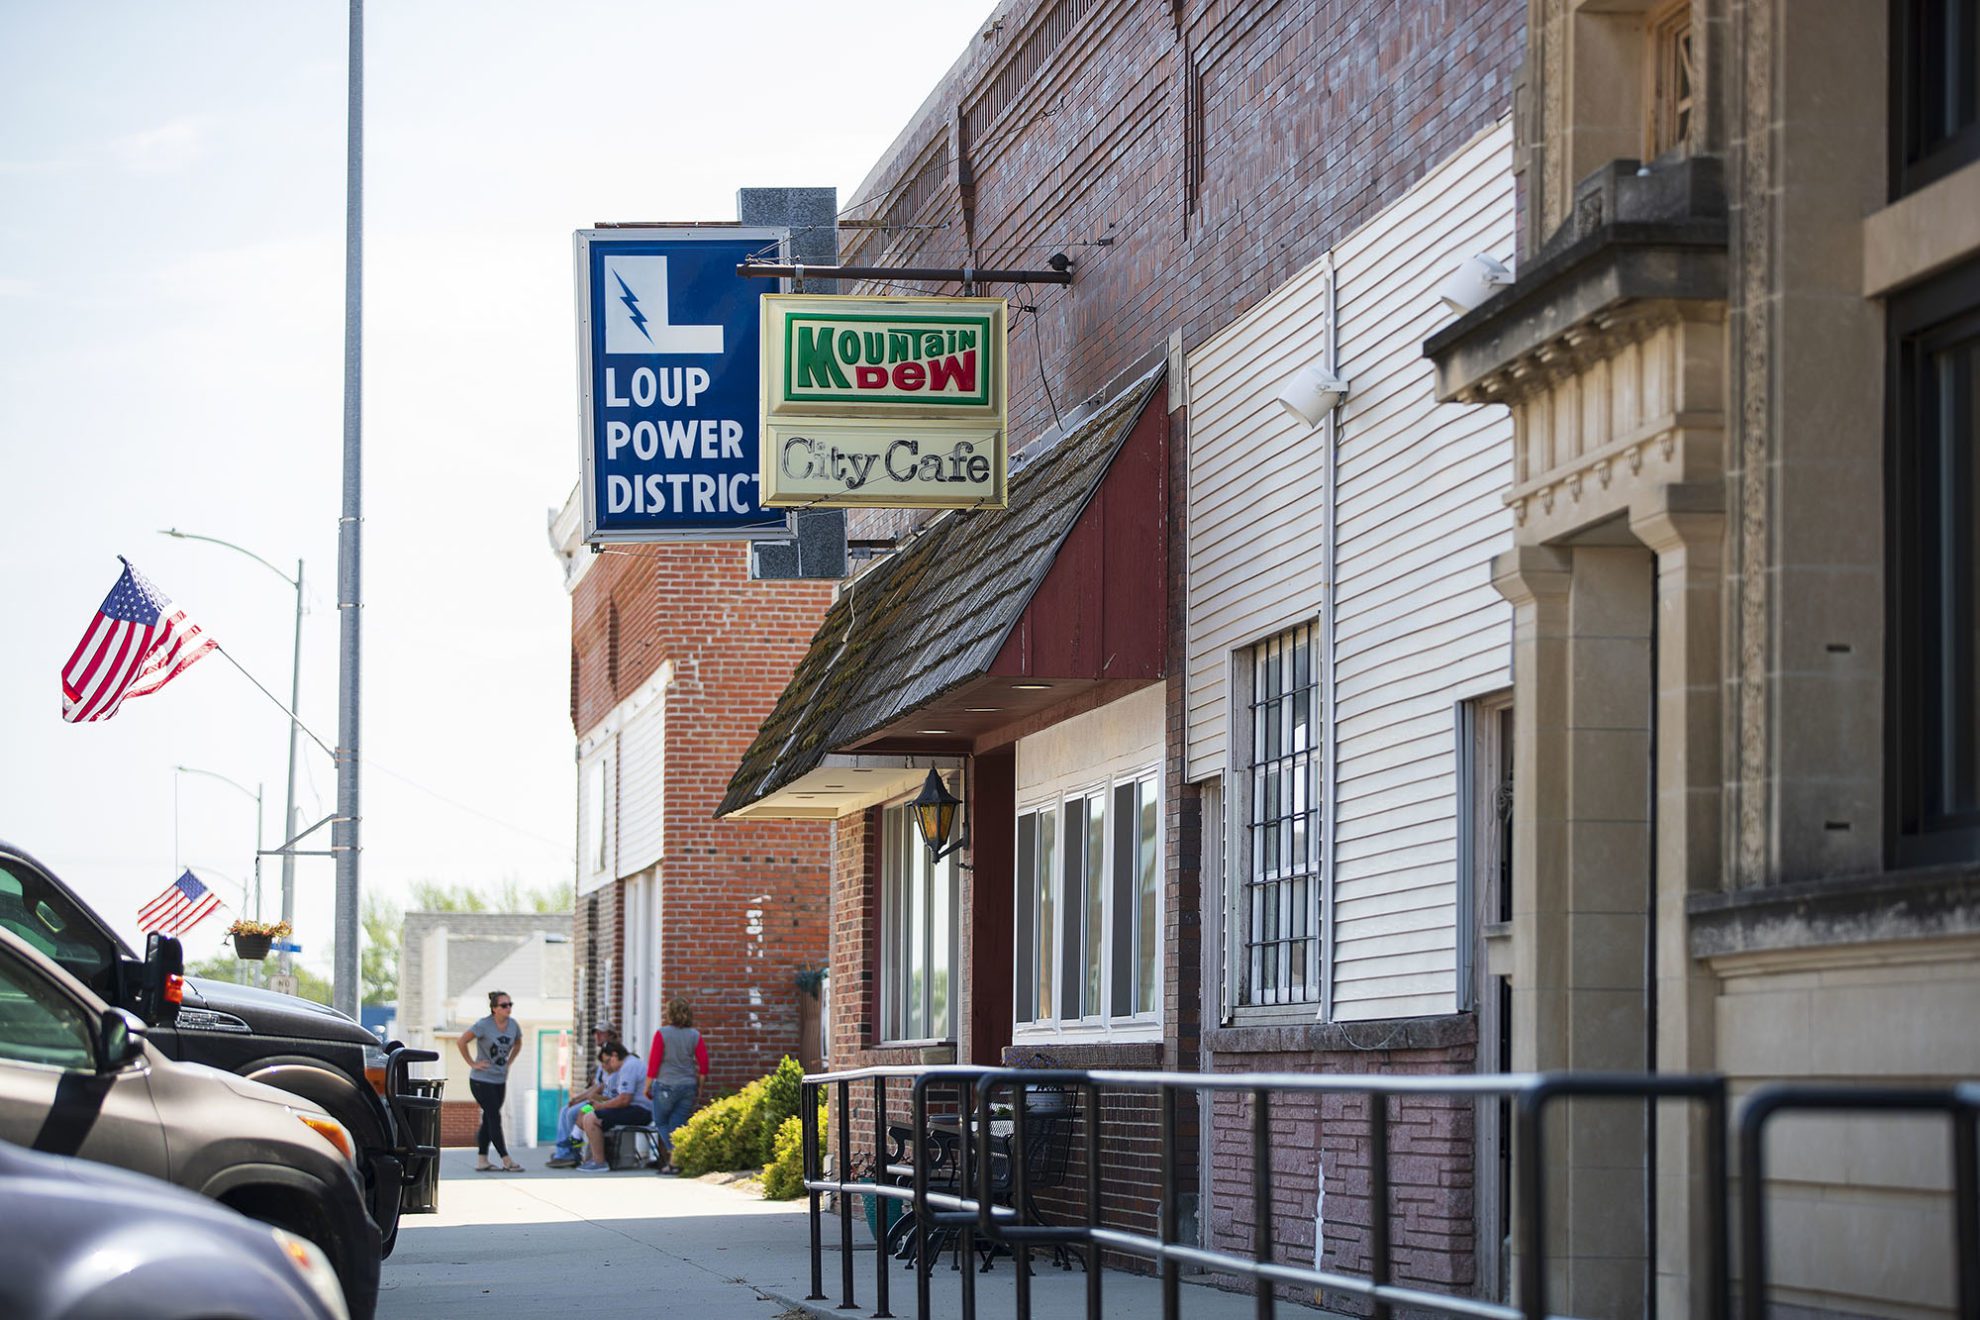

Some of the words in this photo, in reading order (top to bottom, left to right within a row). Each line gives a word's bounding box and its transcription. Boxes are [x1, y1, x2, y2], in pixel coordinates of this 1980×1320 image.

[606, 367, 710, 407] LOUP
[607, 420, 744, 460] POWER
[782, 436, 880, 489] City
[885, 440, 990, 483] Cafe
